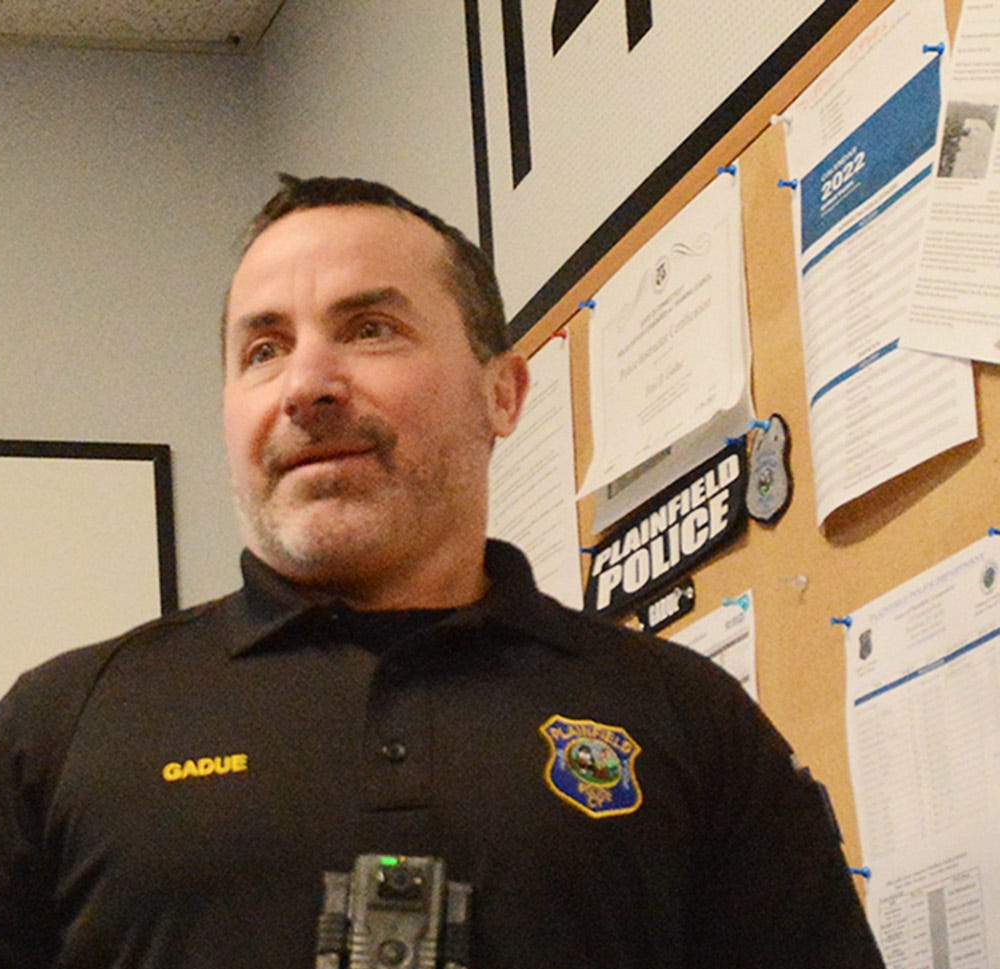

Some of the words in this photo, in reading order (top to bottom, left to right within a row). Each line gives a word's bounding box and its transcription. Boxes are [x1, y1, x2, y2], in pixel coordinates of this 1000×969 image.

[821, 151, 866, 201] 2022
[592, 454, 740, 577] PLAINFIELD
[596, 488, 730, 611] POLICE
[162, 753, 248, 782] GADUE
